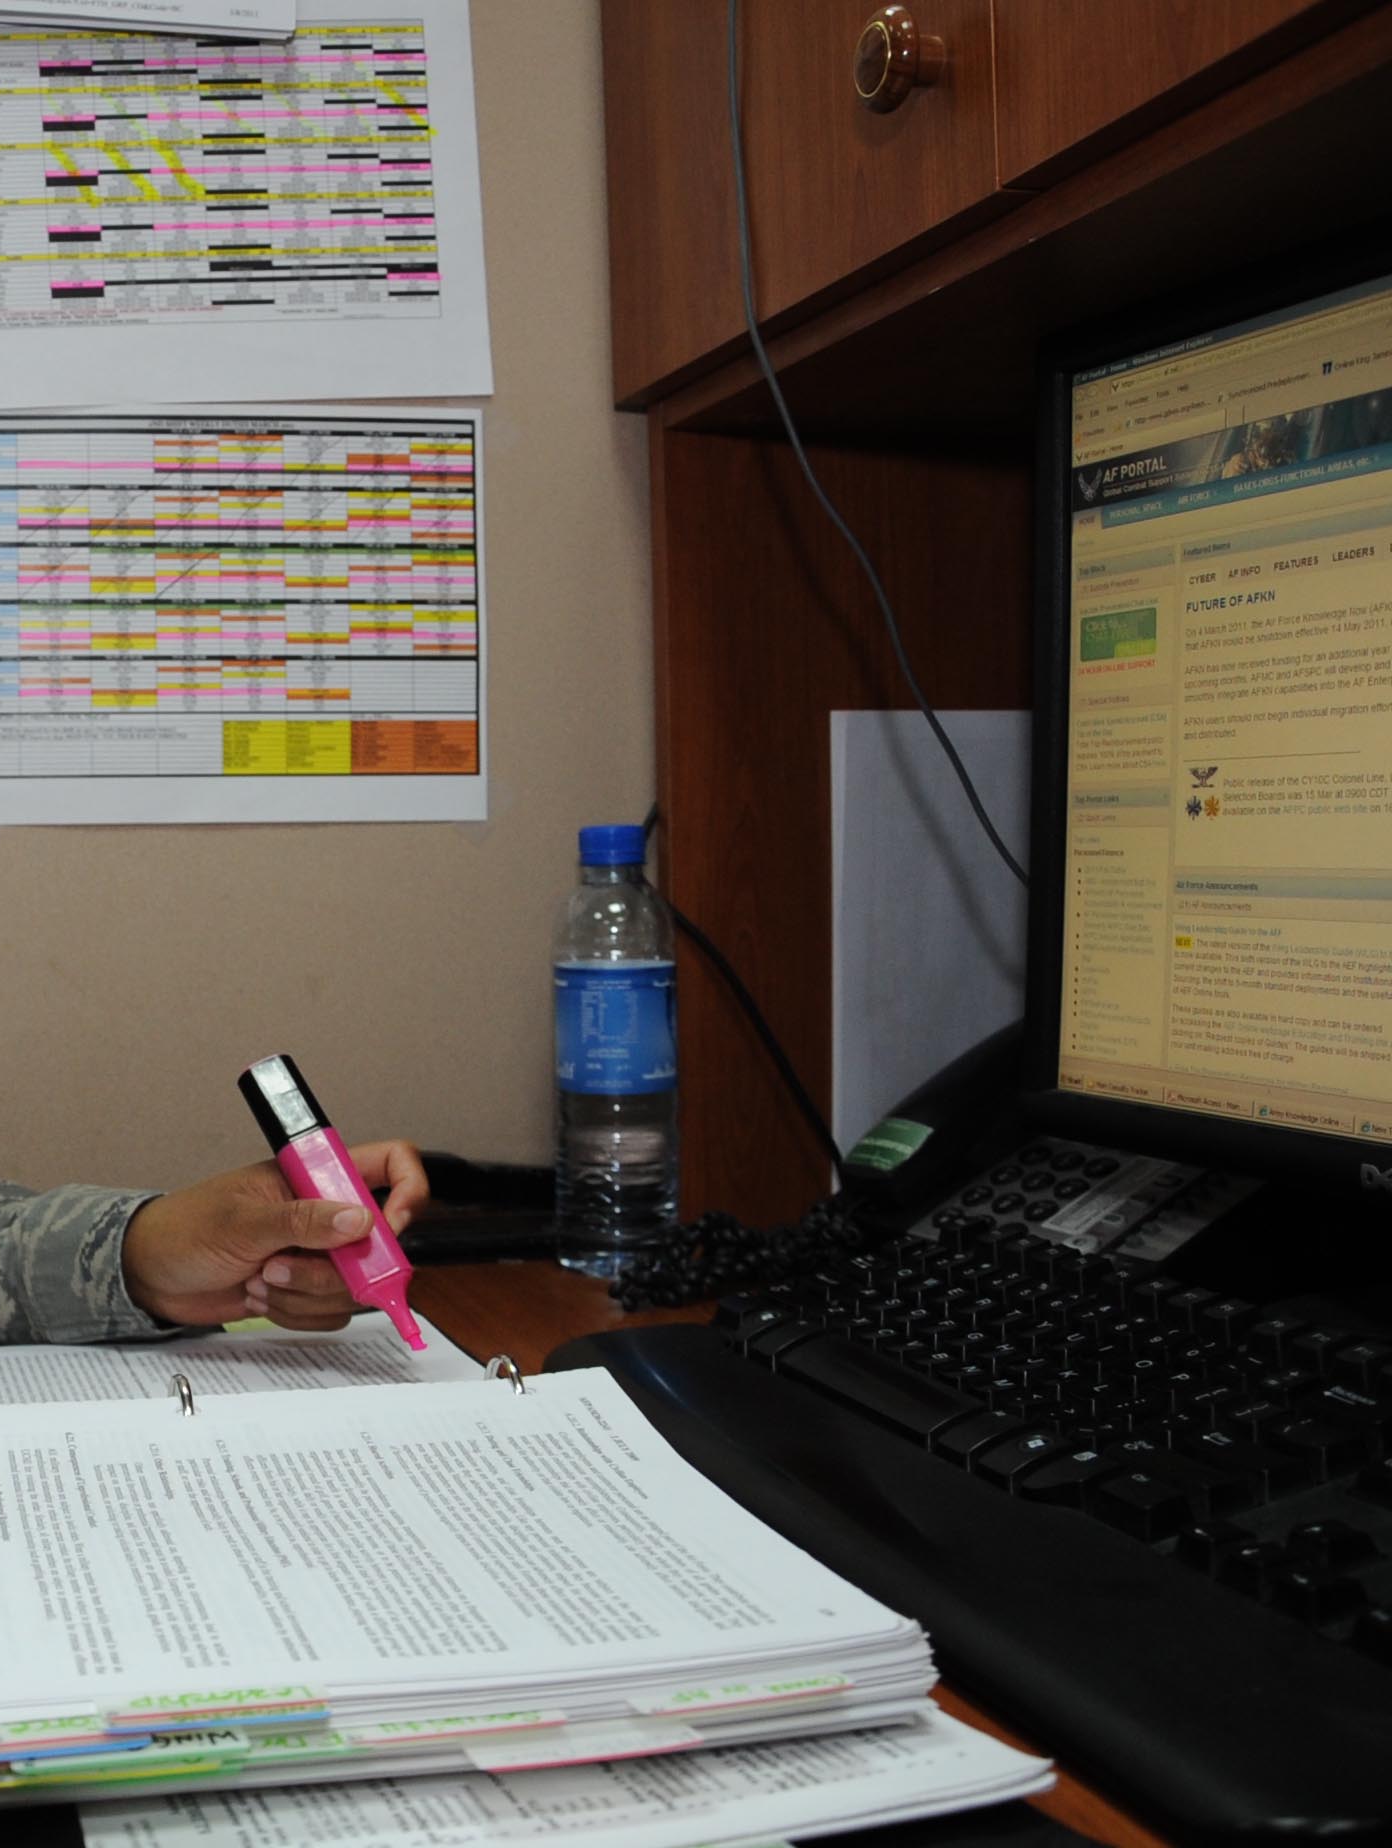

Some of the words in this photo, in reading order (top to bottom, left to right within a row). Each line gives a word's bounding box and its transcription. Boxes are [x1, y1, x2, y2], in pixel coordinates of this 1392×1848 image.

[1103, 467, 1119, 484] AF
[1120, 456, 1167, 478] PORTAL
[1188, 572, 1216, 586] CYBER
[1228, 569, 1238, 578] AF
[1240, 565, 1261, 578] INFO
[1273, 555, 1319, 572] FEATURES
[1332, 546, 1376, 562] LEADERS
[1186, 597, 1226, 613] FUTURE
[1230, 594, 1244, 607] OF
[1246, 590, 1276, 605] AFKN
[1279, 617, 1300, 626] Force
[1296, 625, 1328, 637] effective
[1343, 622, 1360, 631] May
[1185, 665, 1206, 674] AFKN
[1238, 658, 1270, 669] received
[1272, 655, 1301, 665] funding
[1303, 654, 1313, 662] for
[1329, 647, 1368, 659] additional
[1371, 646, 1391, 656] year
[1276, 670, 1291, 679] and
[1293, 667, 1322, 678] AFSPC
[1339, 664, 1371, 674] develop
[1375, 661, 1391, 670] and
[1251, 686, 1273, 696] AFKN
[1275, 683, 1318, 695] capabilities
[1320, 681, 1335, 690] into
[1338, 680, 1351, 688] the
[1268, 710, 1288, 721] begin
[1291, 707, 1328, 717] individual
[1331, 704, 1368, 716] migration
[1223, 778, 1244, 787] Public
[1287, 776, 1299, 785] the
[1332, 774, 1364, 784] Colonel
[1223, 792, 1256, 801] Selection
[1258, 791, 1285, 800] Boards
[1318, 791, 1332, 799] Mar
[1223, 806, 1254, 815] available
[1268, 806, 1280, 814] the
[1278, 1015, 1293, 1024] hard
[1313, 1019, 1326, 1027] and
[1296, 1042, 1308, 1051] The
[1310, 1045, 1333, 1054] guides
[129, 1685, 314, 1709] Leadership
